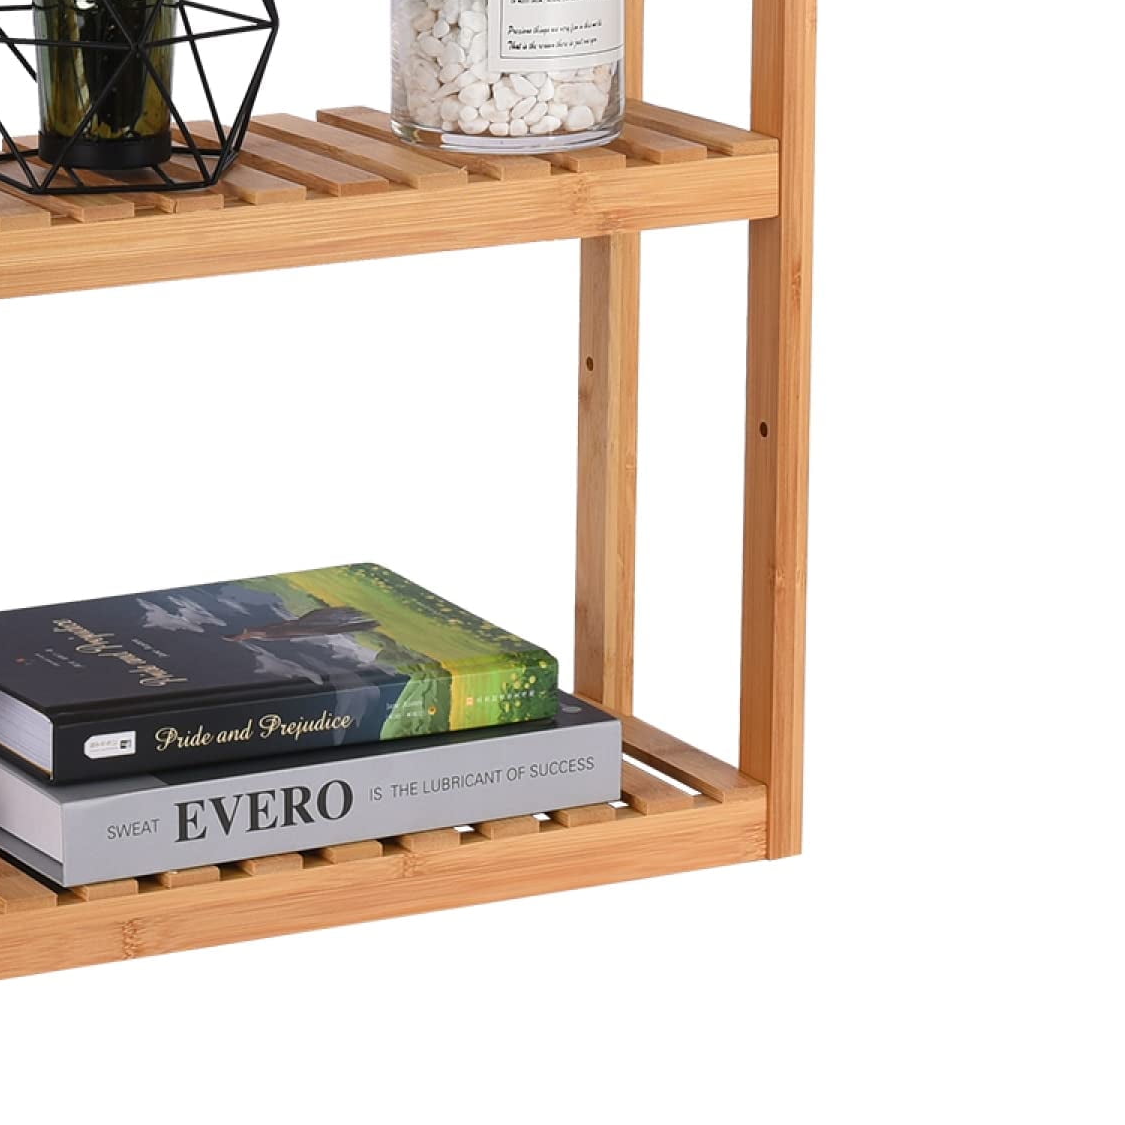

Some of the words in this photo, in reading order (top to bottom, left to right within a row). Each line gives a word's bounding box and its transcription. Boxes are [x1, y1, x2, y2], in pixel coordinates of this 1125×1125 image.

[155, 726, 214, 752] Pride
[216, 718, 254, 744] and
[259, 710, 354, 741] Prejudice
[106, 819, 160, 840] SWEAT
[174, 779, 354, 843] EVERO
[370, 787, 382, 801] IS
[391, 782, 418, 798] THE
[423, 769, 502, 794] LUBRICANT
[506, 766, 525, 781] OF
[529, 756, 595, 778] SUCCESS
